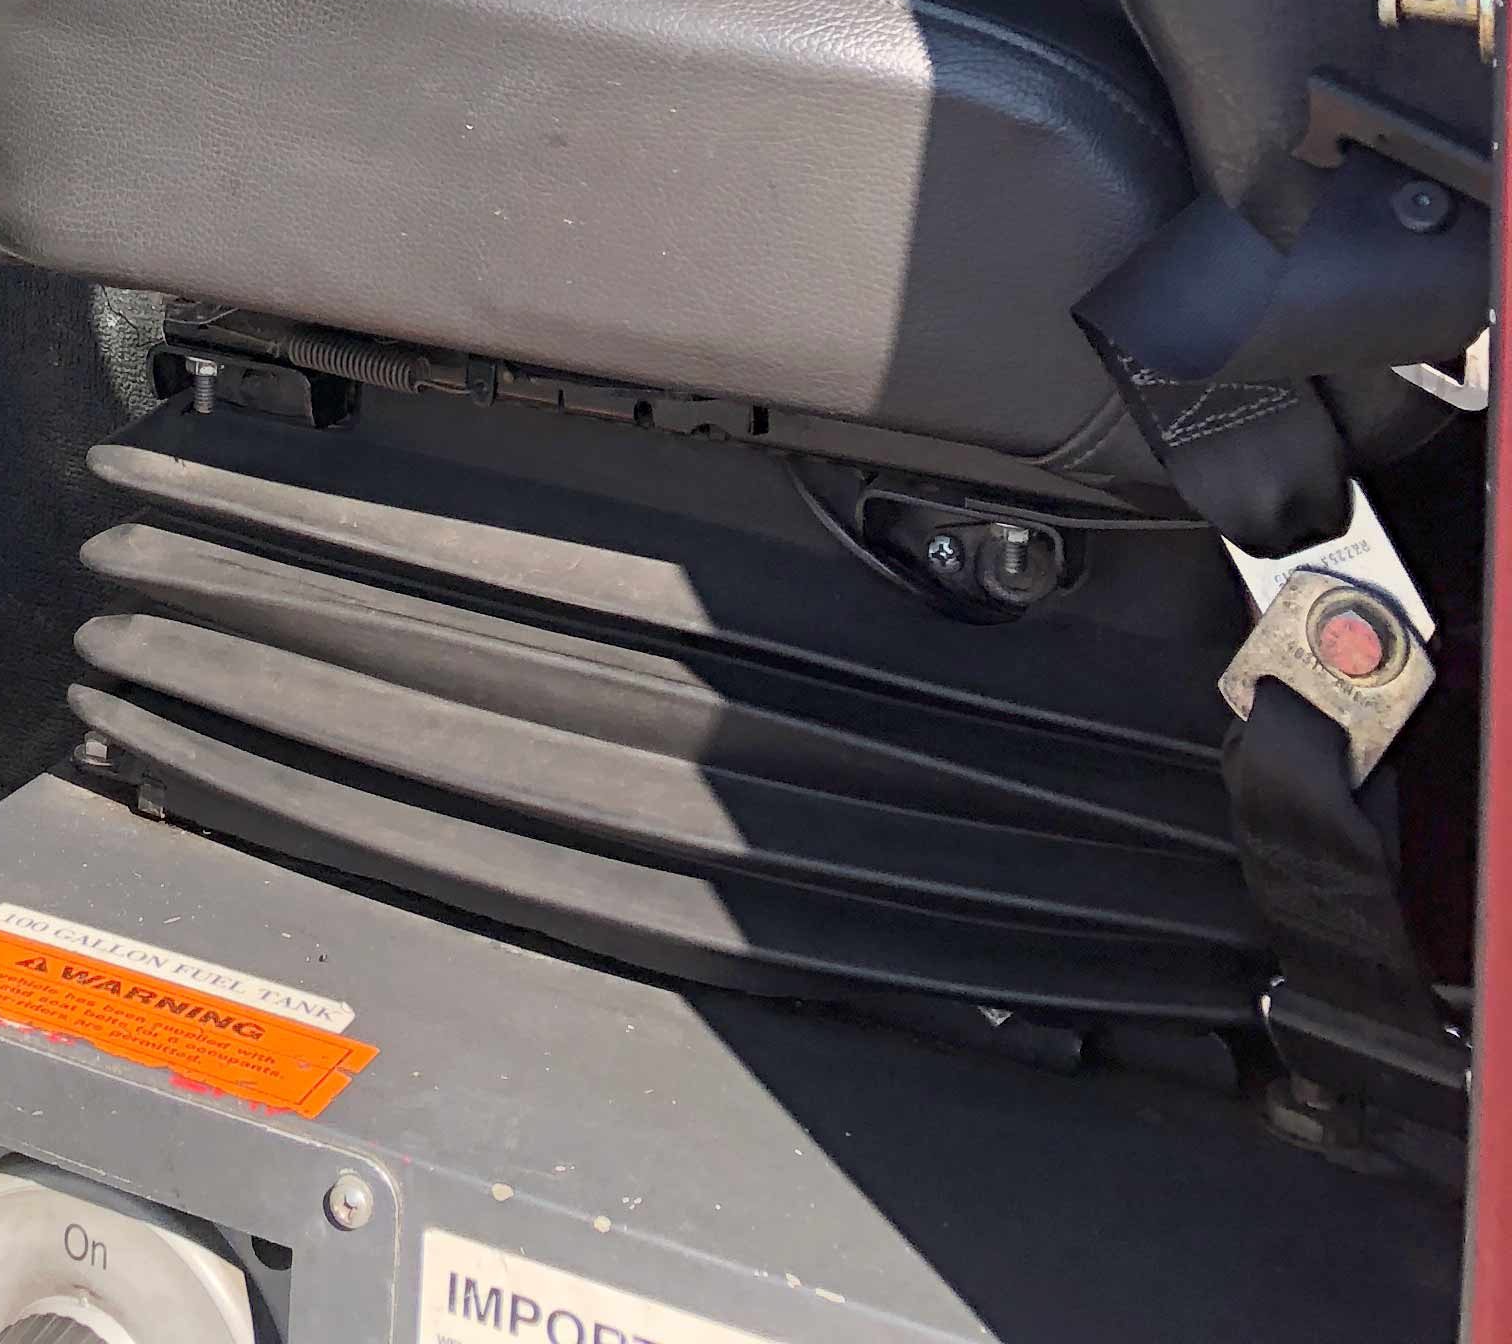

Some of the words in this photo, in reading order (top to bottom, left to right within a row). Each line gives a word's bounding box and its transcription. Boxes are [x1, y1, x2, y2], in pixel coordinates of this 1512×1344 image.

[2, 912, 50, 934] 100
[53, 928, 171, 970] GALLON
[172, 961, 247, 995] FUEL
[259, 986, 337, 1023] TANK
[60, 965, 268, 1041] WARNING
[0, 973, 60, 995] vehicle
[64, 992, 97, 1008] has
[102, 1004, 146, 1024] been
[151, 1021, 232, 1050] supplied
[237, 1047, 277, 1065] with
[0, 984, 36, 998] and
[38, 996, 78, 1012] seat
[83, 1008, 129, 1029] belts
[135, 1025, 160, 1039] for
[185, 1042, 285, 1080] occupants.
[72, 1018, 105, 1032] are
[108, 1029, 202, 1065] permitted.
[63, 1222, 108, 1271] On
[447, 1270, 660, 1344] IMPOR
